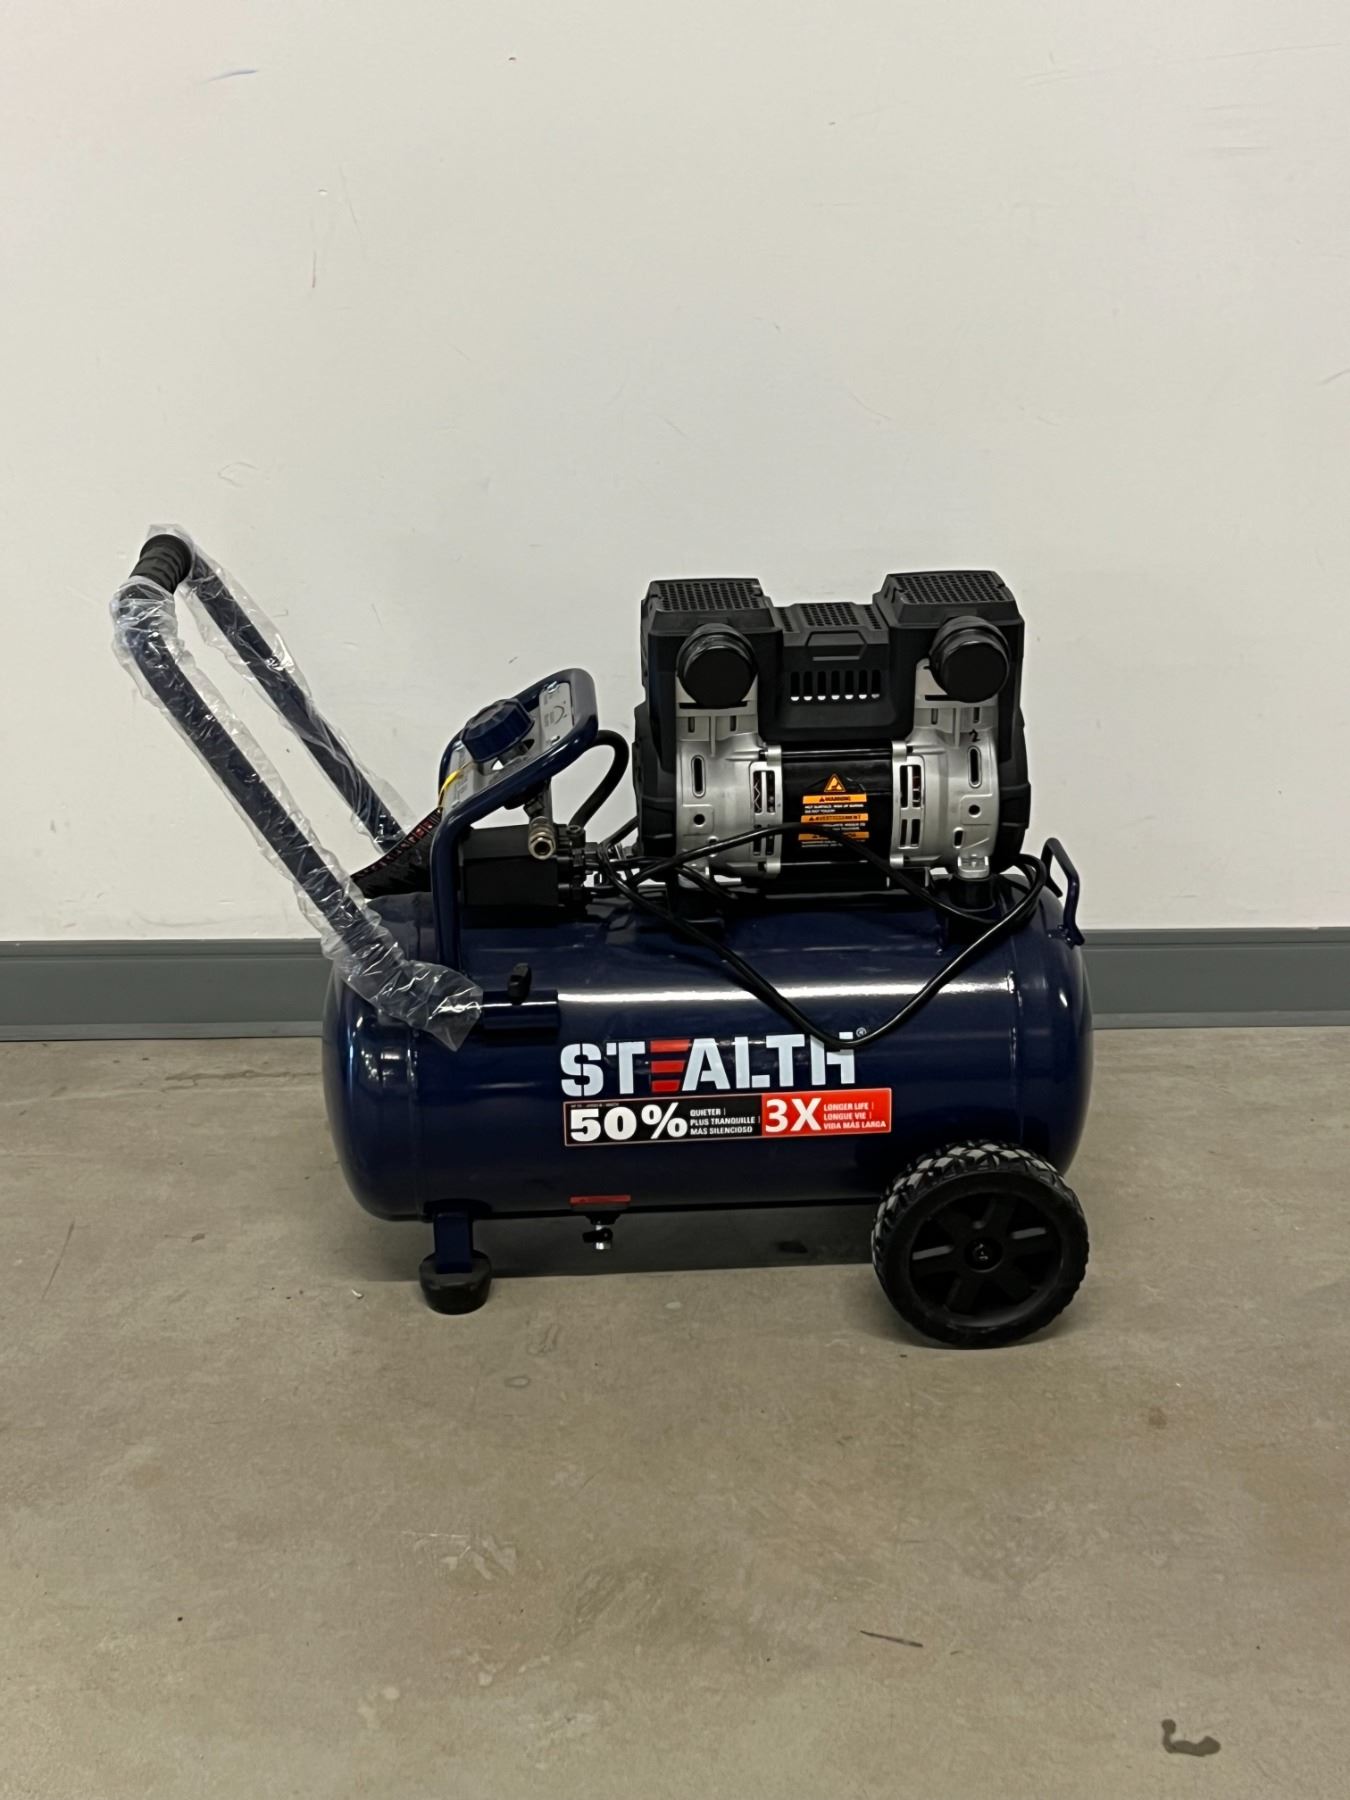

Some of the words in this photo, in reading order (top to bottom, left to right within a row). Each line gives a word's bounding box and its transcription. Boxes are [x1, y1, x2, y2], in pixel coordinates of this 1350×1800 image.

[560, 1032, 855, 1096] STEALTH
[823, 1103, 853, 1112] LONGER
[854, 1102, 869, 1111] LIFE
[690, 1108, 721, 1117] QUIETER
[765, 1097, 822, 1133] 3X
[823, 1112, 853, 1121] LONGUE
[854, 1111, 867, 1120] VIE
[570, 1102, 688, 1142] 50%
[690, 1118, 710, 1126] PLUS
[711, 1116, 755, 1125] TRANQUILLE
[709, 1125, 753, 1134] SILENCIOSO
